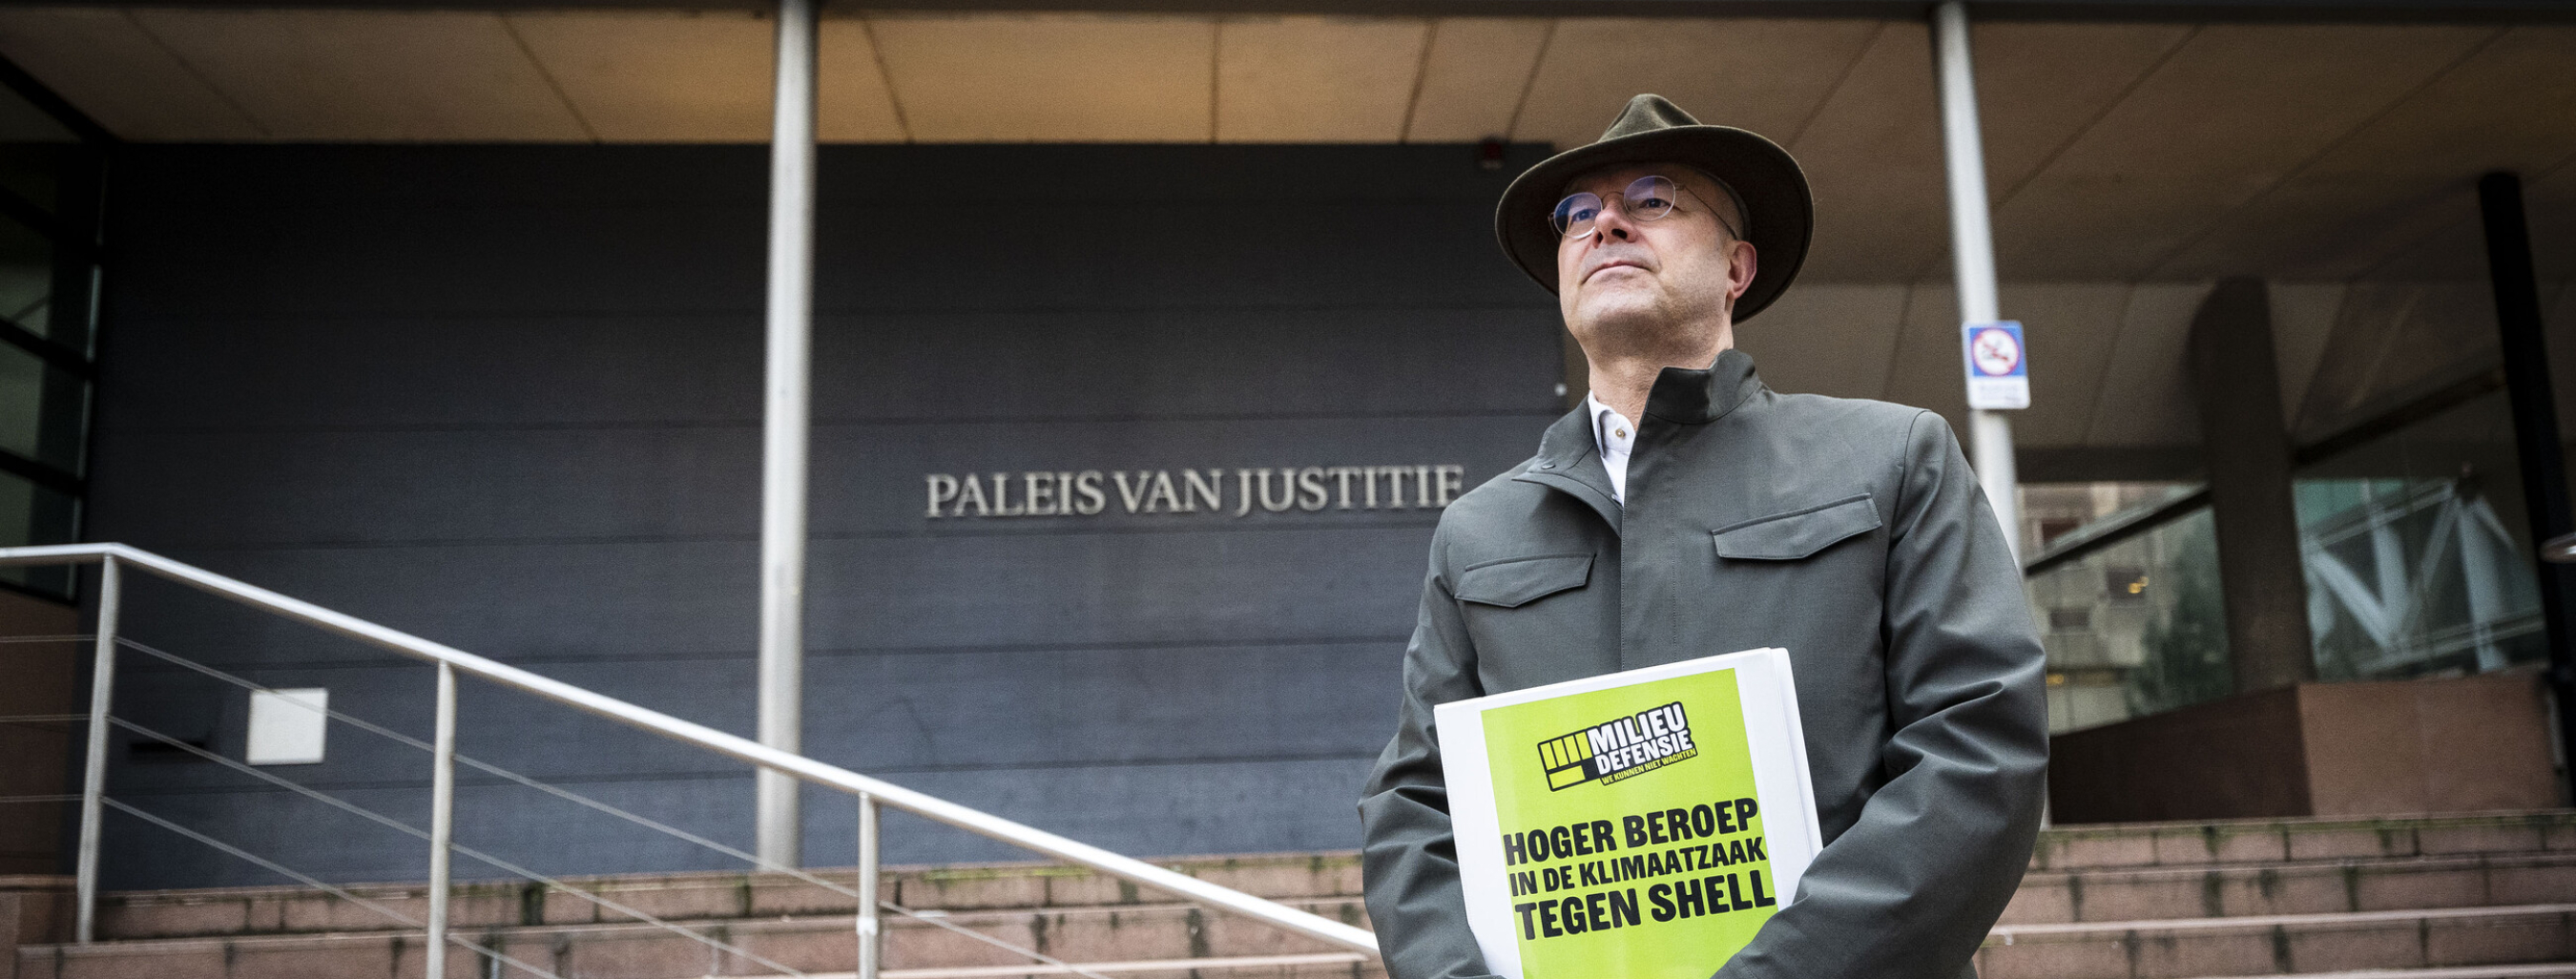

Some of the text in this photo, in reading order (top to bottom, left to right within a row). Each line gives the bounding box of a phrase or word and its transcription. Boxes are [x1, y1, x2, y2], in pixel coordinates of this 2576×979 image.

[925, 465, 1465, 517] PALEIS VAN JUSTITIE
[1587, 702, 1686, 756] MILIEU
[1594, 729, 1693, 775] DEFENSIE
[1602, 747, 1697, 785] WE KUNNEN NIET WACHTEN
[1503, 798, 1758, 865] HOGER BEROEP
[1509, 836, 1767, 897] IN DE KLIMAATZAAK
[1515, 869, 1776, 941] TEGEN SHELL
